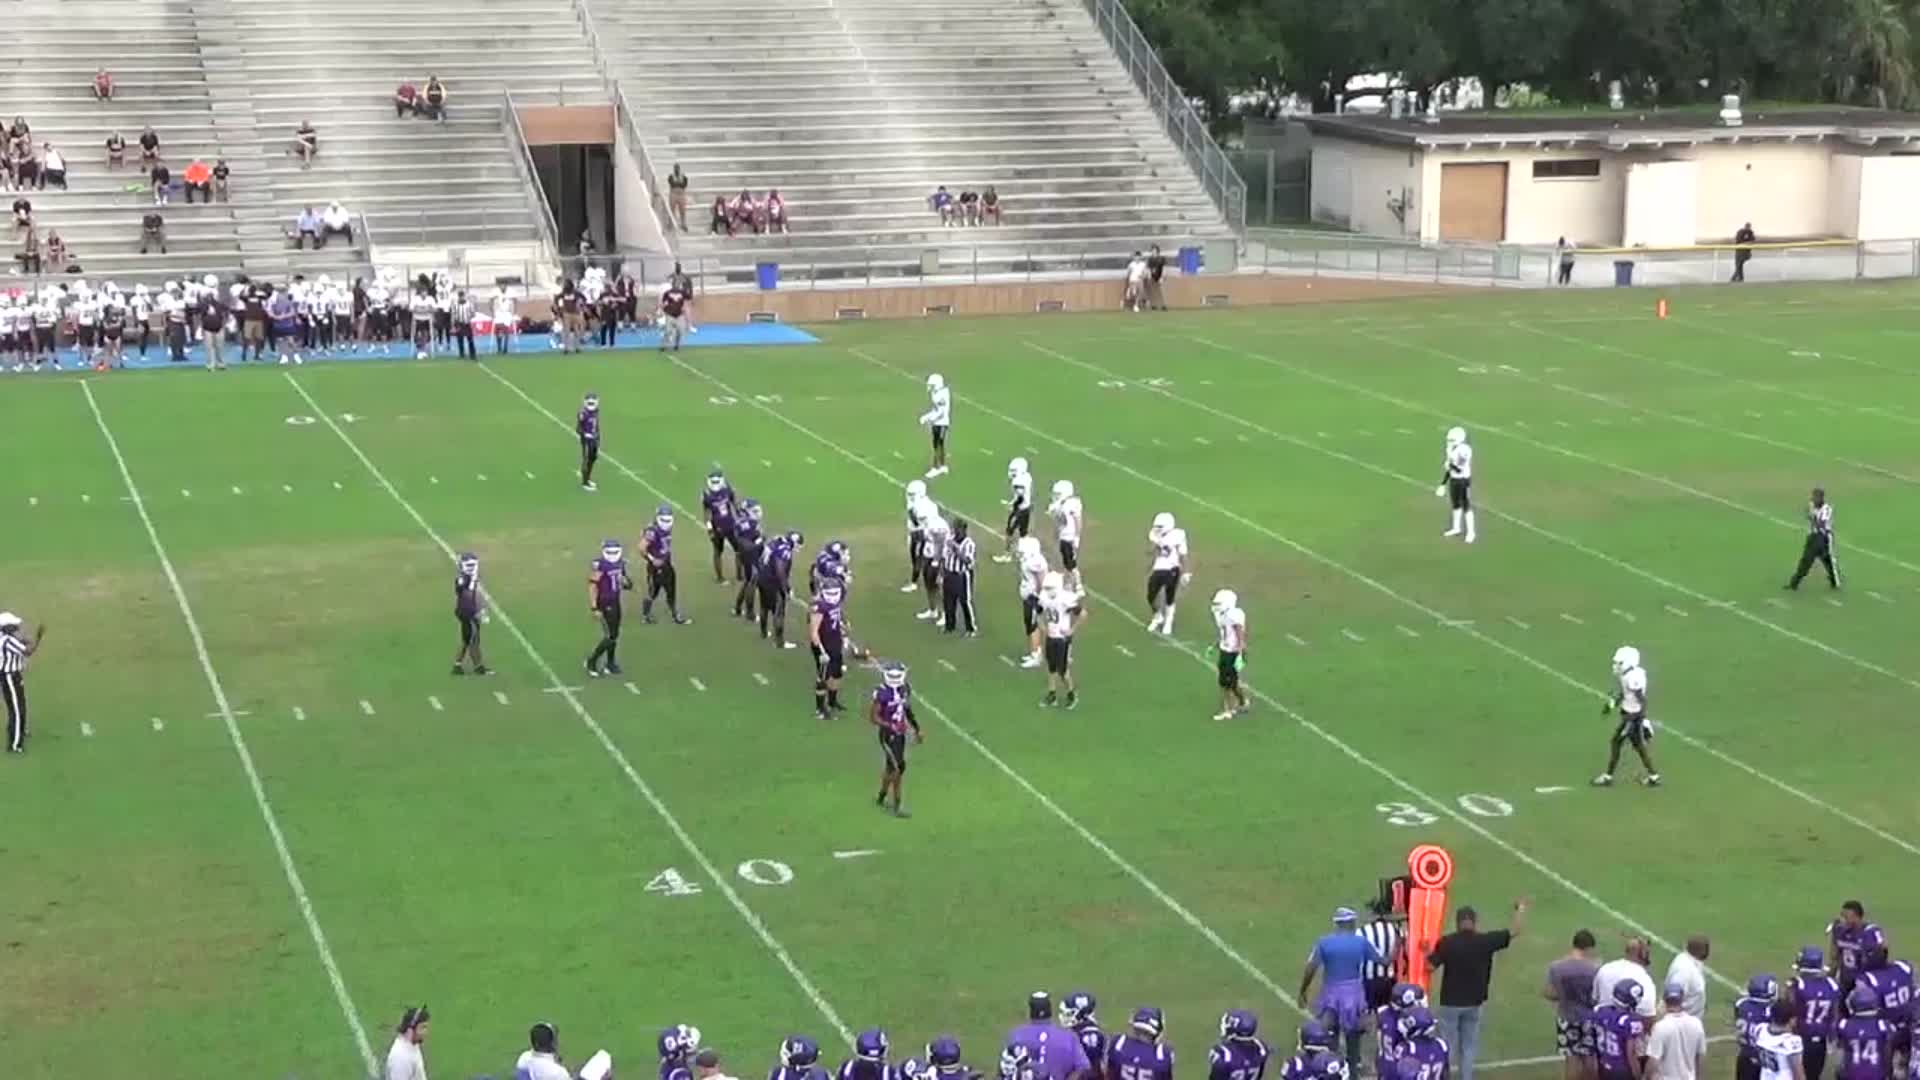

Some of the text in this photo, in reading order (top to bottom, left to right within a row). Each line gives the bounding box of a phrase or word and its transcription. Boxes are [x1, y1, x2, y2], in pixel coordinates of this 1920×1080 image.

[1375, 792, 1513, 827] 30
[643, 858, 793, 897] 40
[1805, 999, 1831, 1024] 17
[1850, 1039, 1879, 1064] 14
